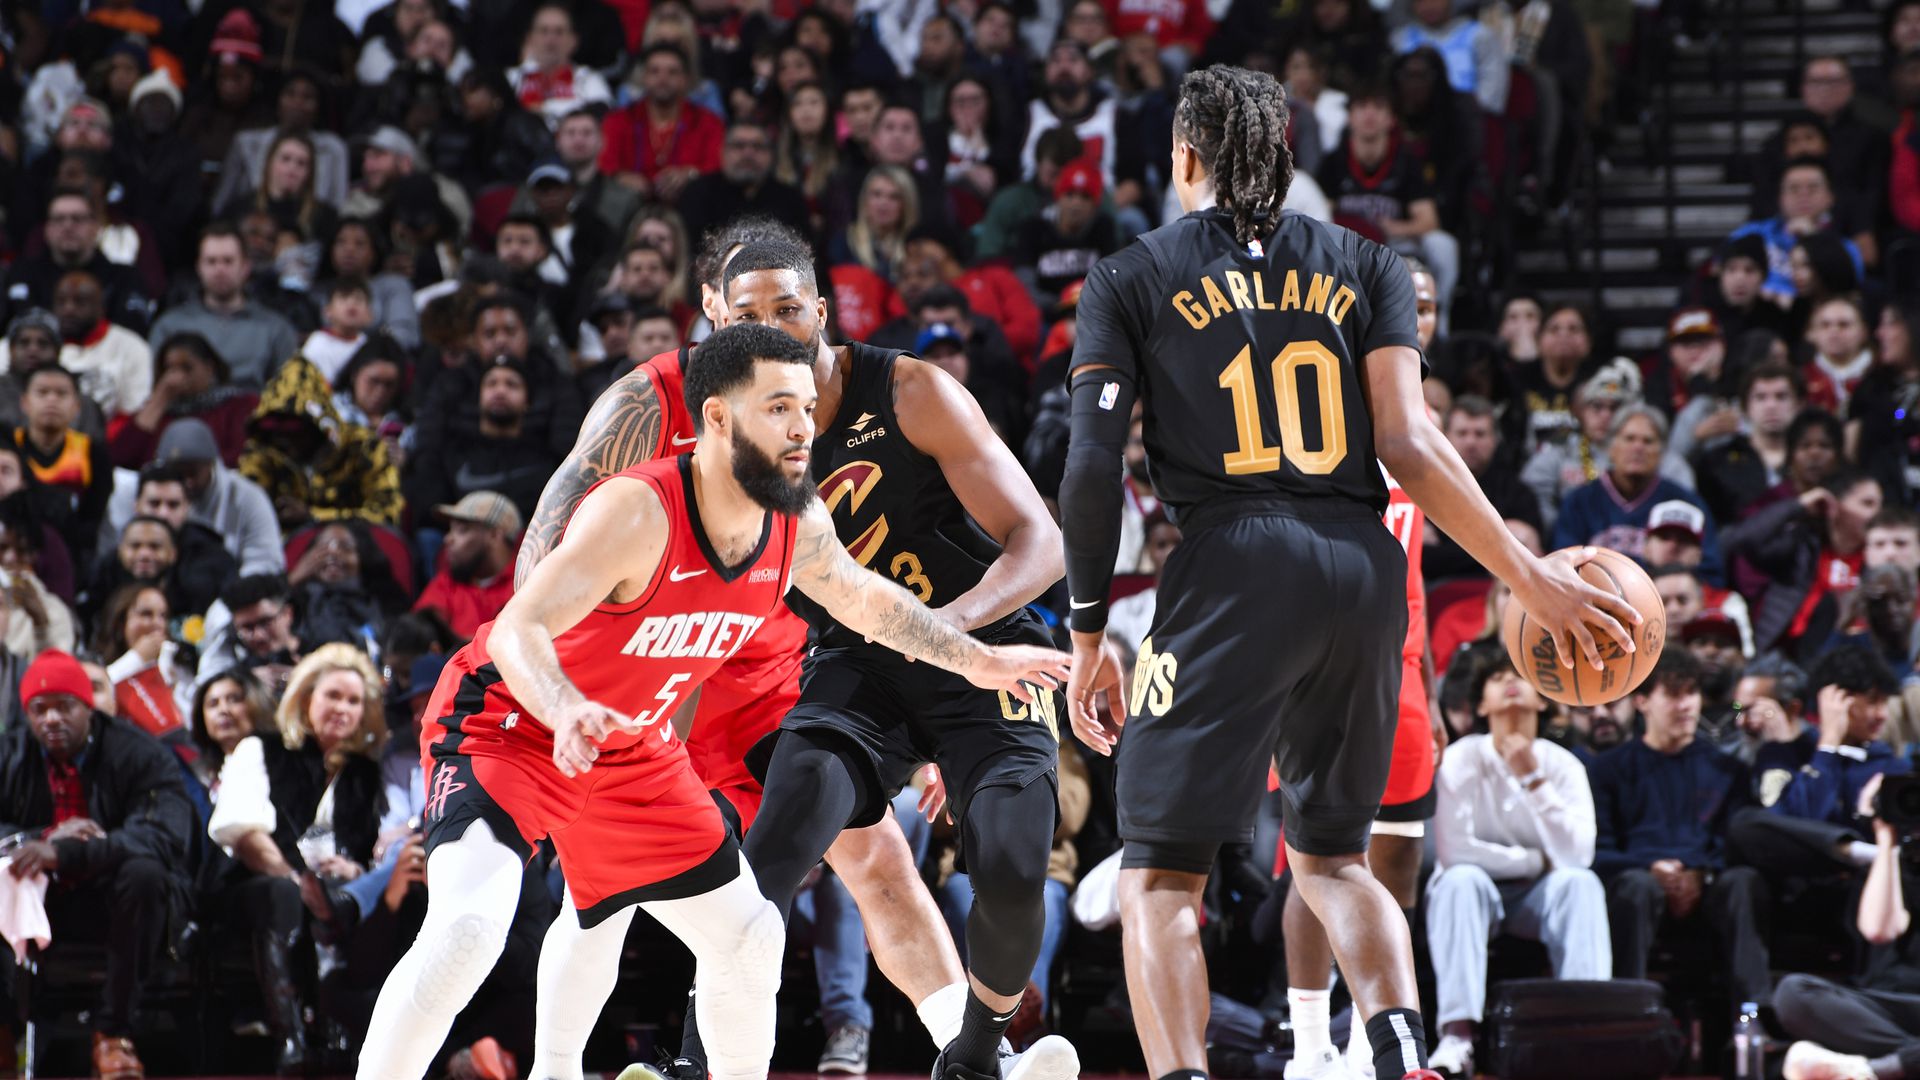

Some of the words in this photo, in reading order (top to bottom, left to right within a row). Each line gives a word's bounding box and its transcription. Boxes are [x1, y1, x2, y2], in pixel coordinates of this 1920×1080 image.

[1172, 269, 1356, 330] GARLAND
[1218, 340, 1347, 475] 10
[846, 427, 887, 448] CLIFFS
[873, 551, 934, 604] 3
[631, 672, 692, 727] 5
